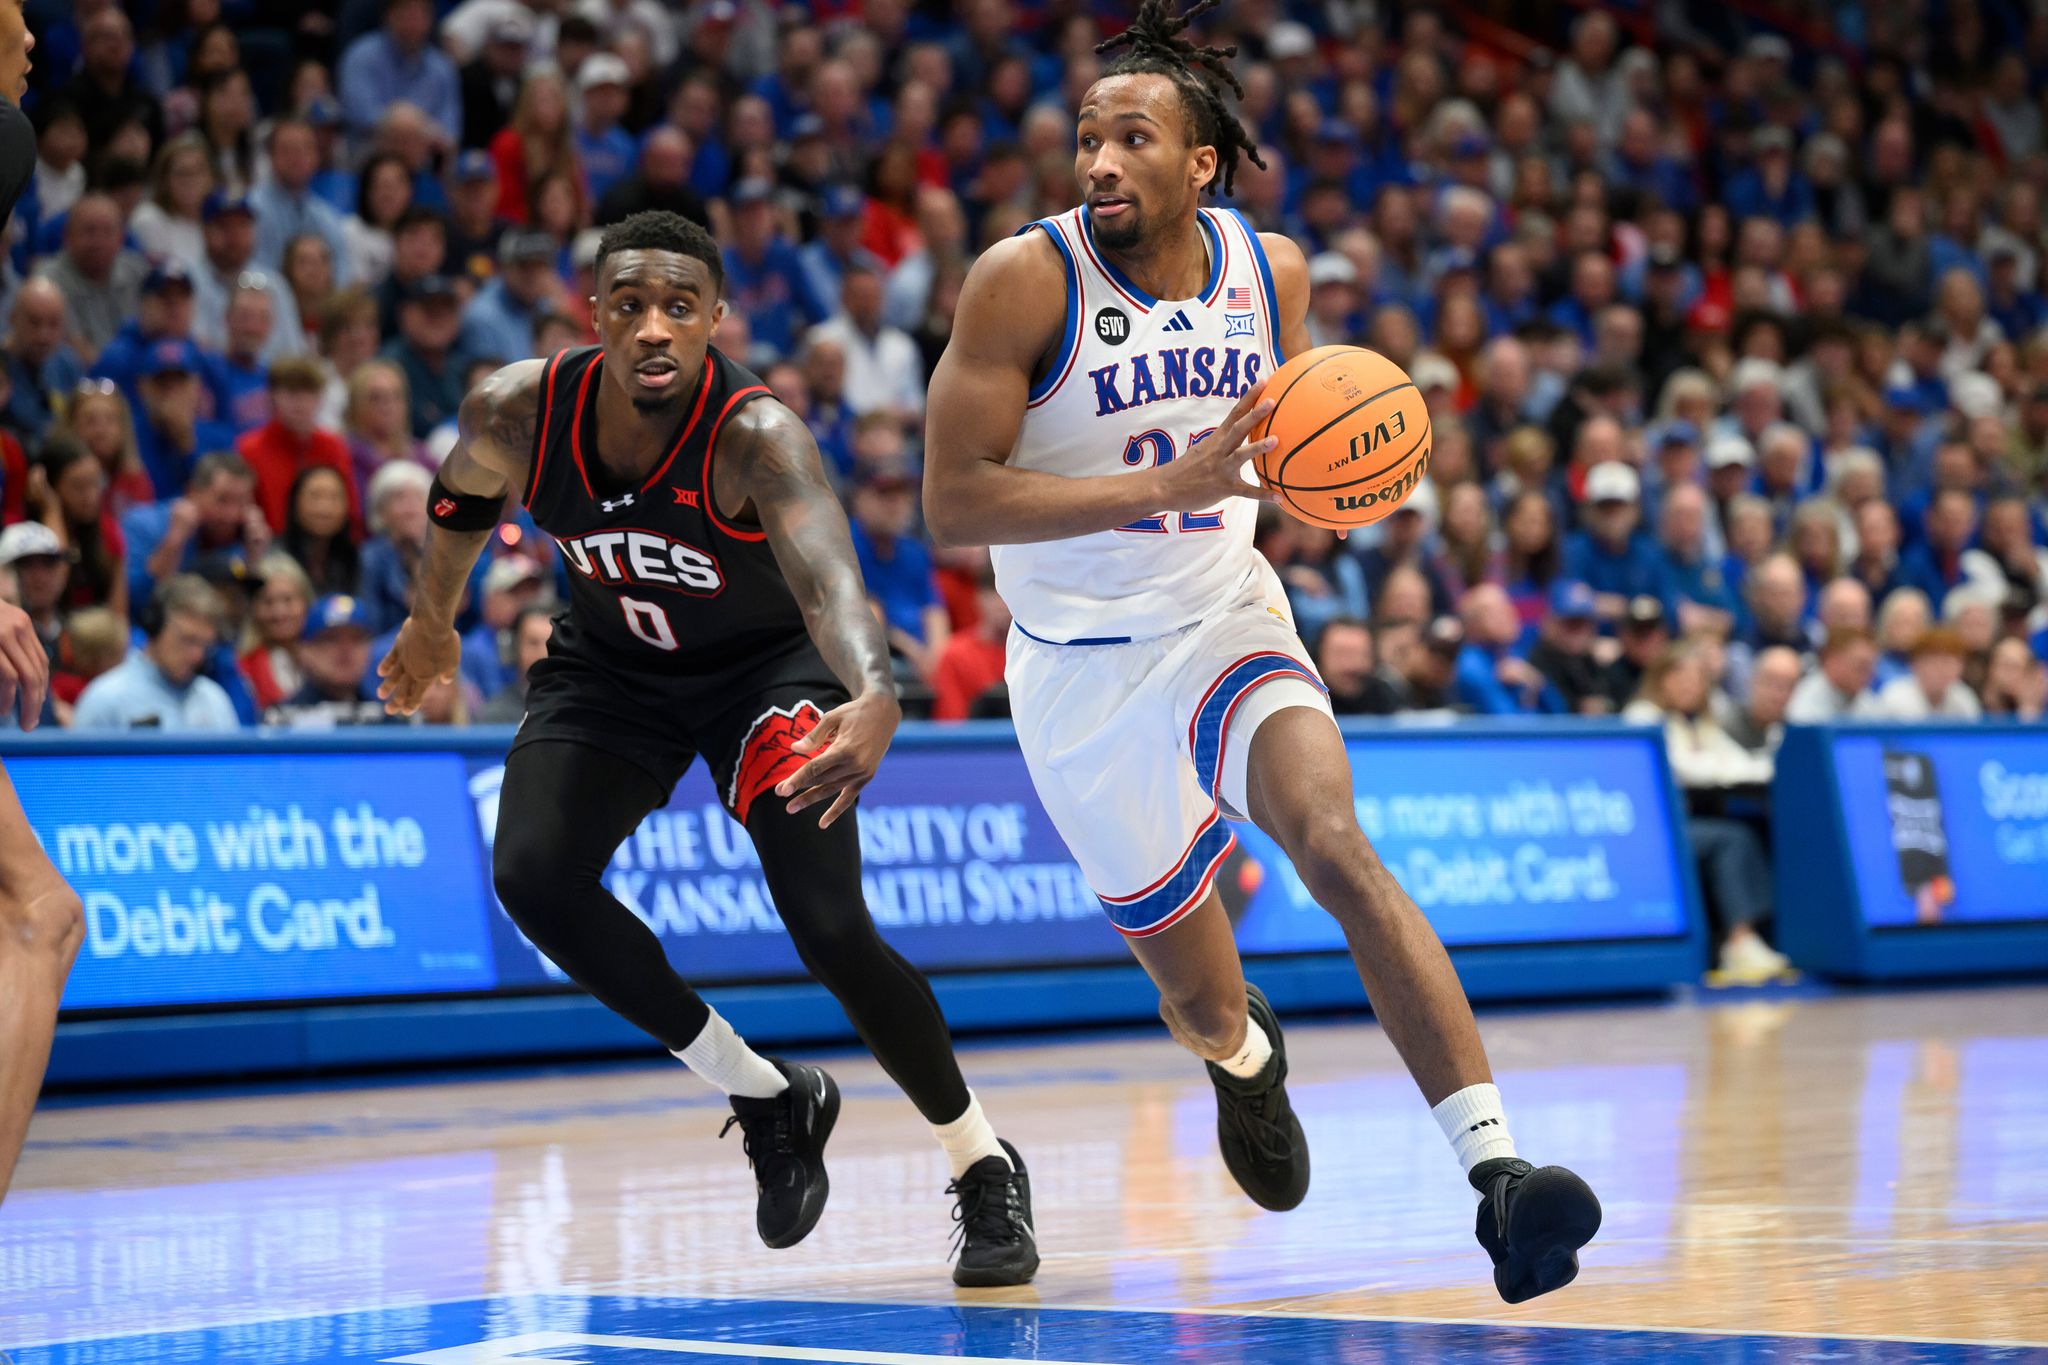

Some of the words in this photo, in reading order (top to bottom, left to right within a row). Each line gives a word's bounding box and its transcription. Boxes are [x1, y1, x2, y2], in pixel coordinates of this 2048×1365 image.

[1099, 316, 1125, 337] SW
[1088, 346, 1261, 417] KANSAS
[1327, 456, 1350, 473] NXT
[1333, 447, 1431, 512] Wilson
[672, 487, 700, 508] XII
[554, 530, 722, 592] UTES
[619, 596, 680, 651] 0
[56, 822, 198, 875] more
[206, 804, 328, 871] with
[333, 800, 425, 868] the
[967, 802, 1028, 863] OF
[86, 887, 240, 959] Debit
[248, 882, 396, 952] Card.
